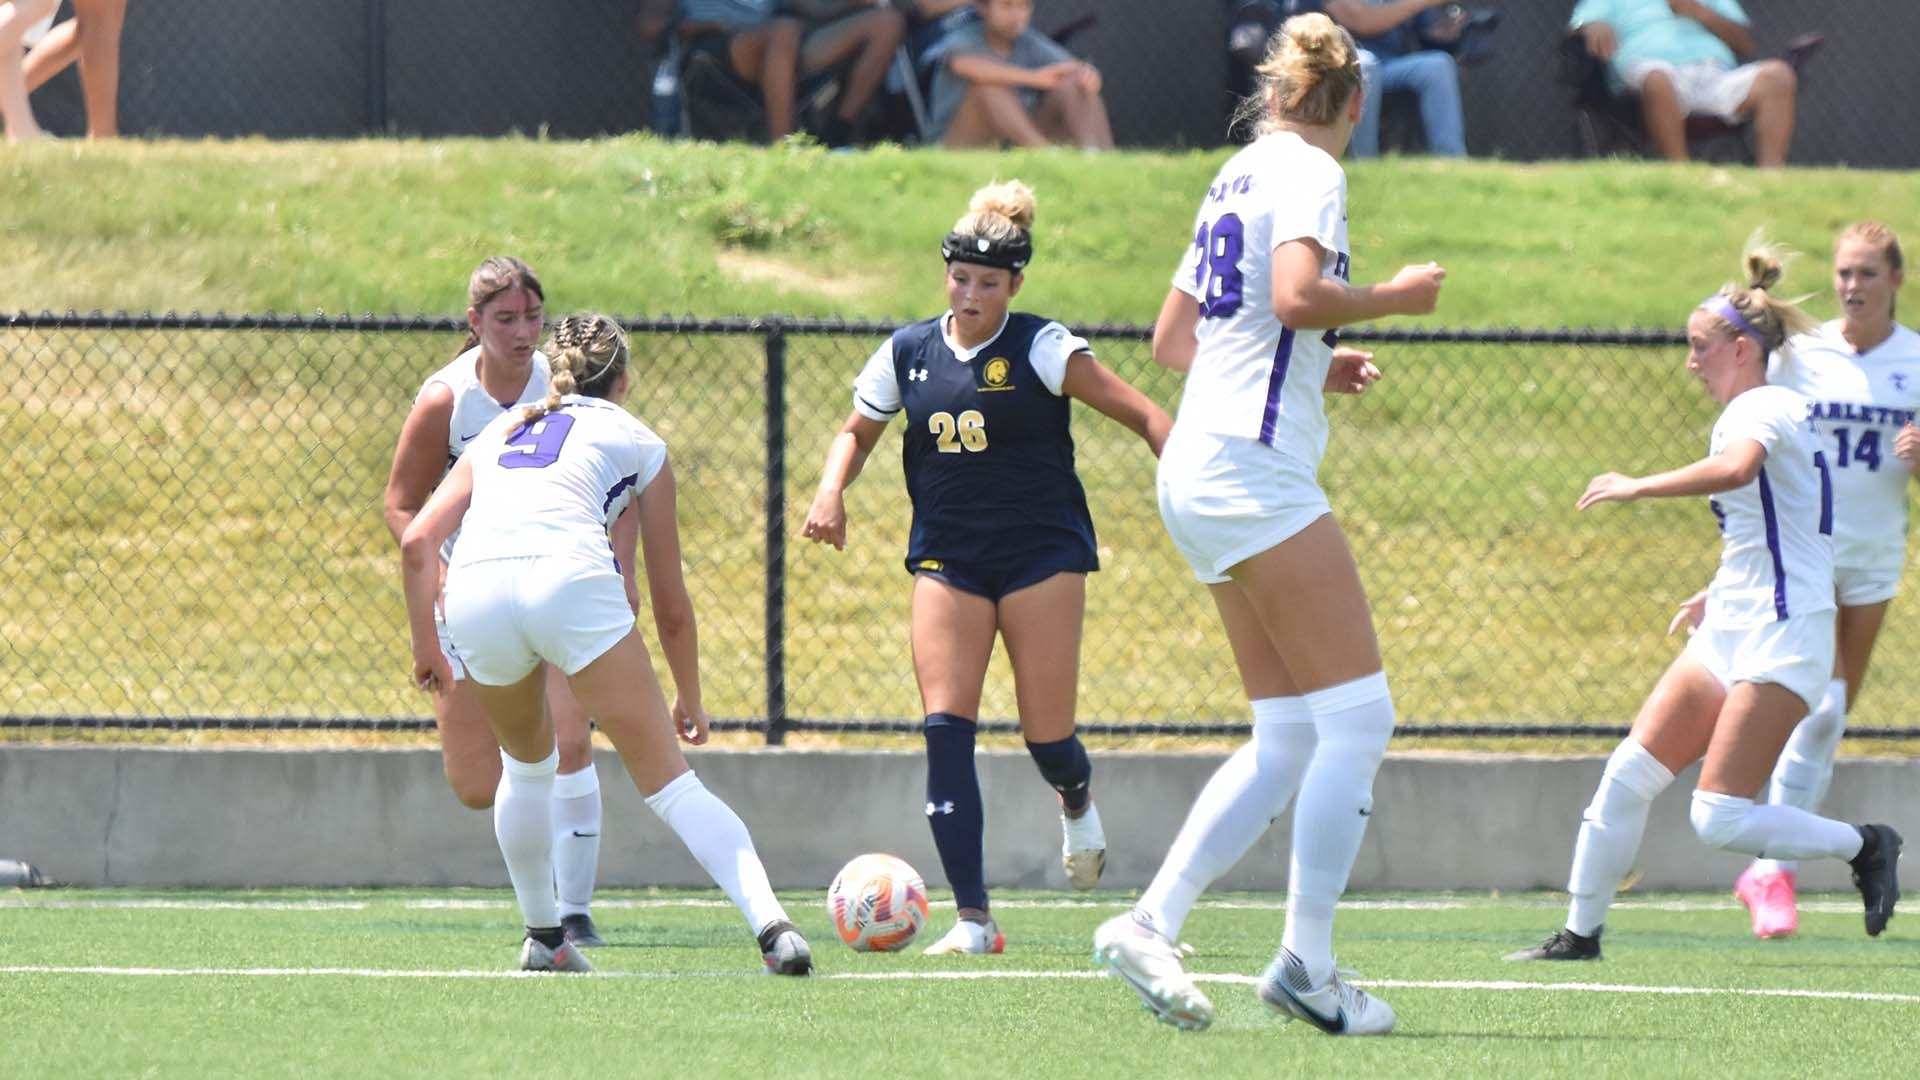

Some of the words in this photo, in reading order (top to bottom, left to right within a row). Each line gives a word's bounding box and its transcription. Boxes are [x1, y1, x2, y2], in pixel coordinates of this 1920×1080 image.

[497, 412, 576, 469] 9
[928, 409, 989, 454] 26
[1833, 427, 1881, 472] 14
[1814, 450, 1833, 536] 1
